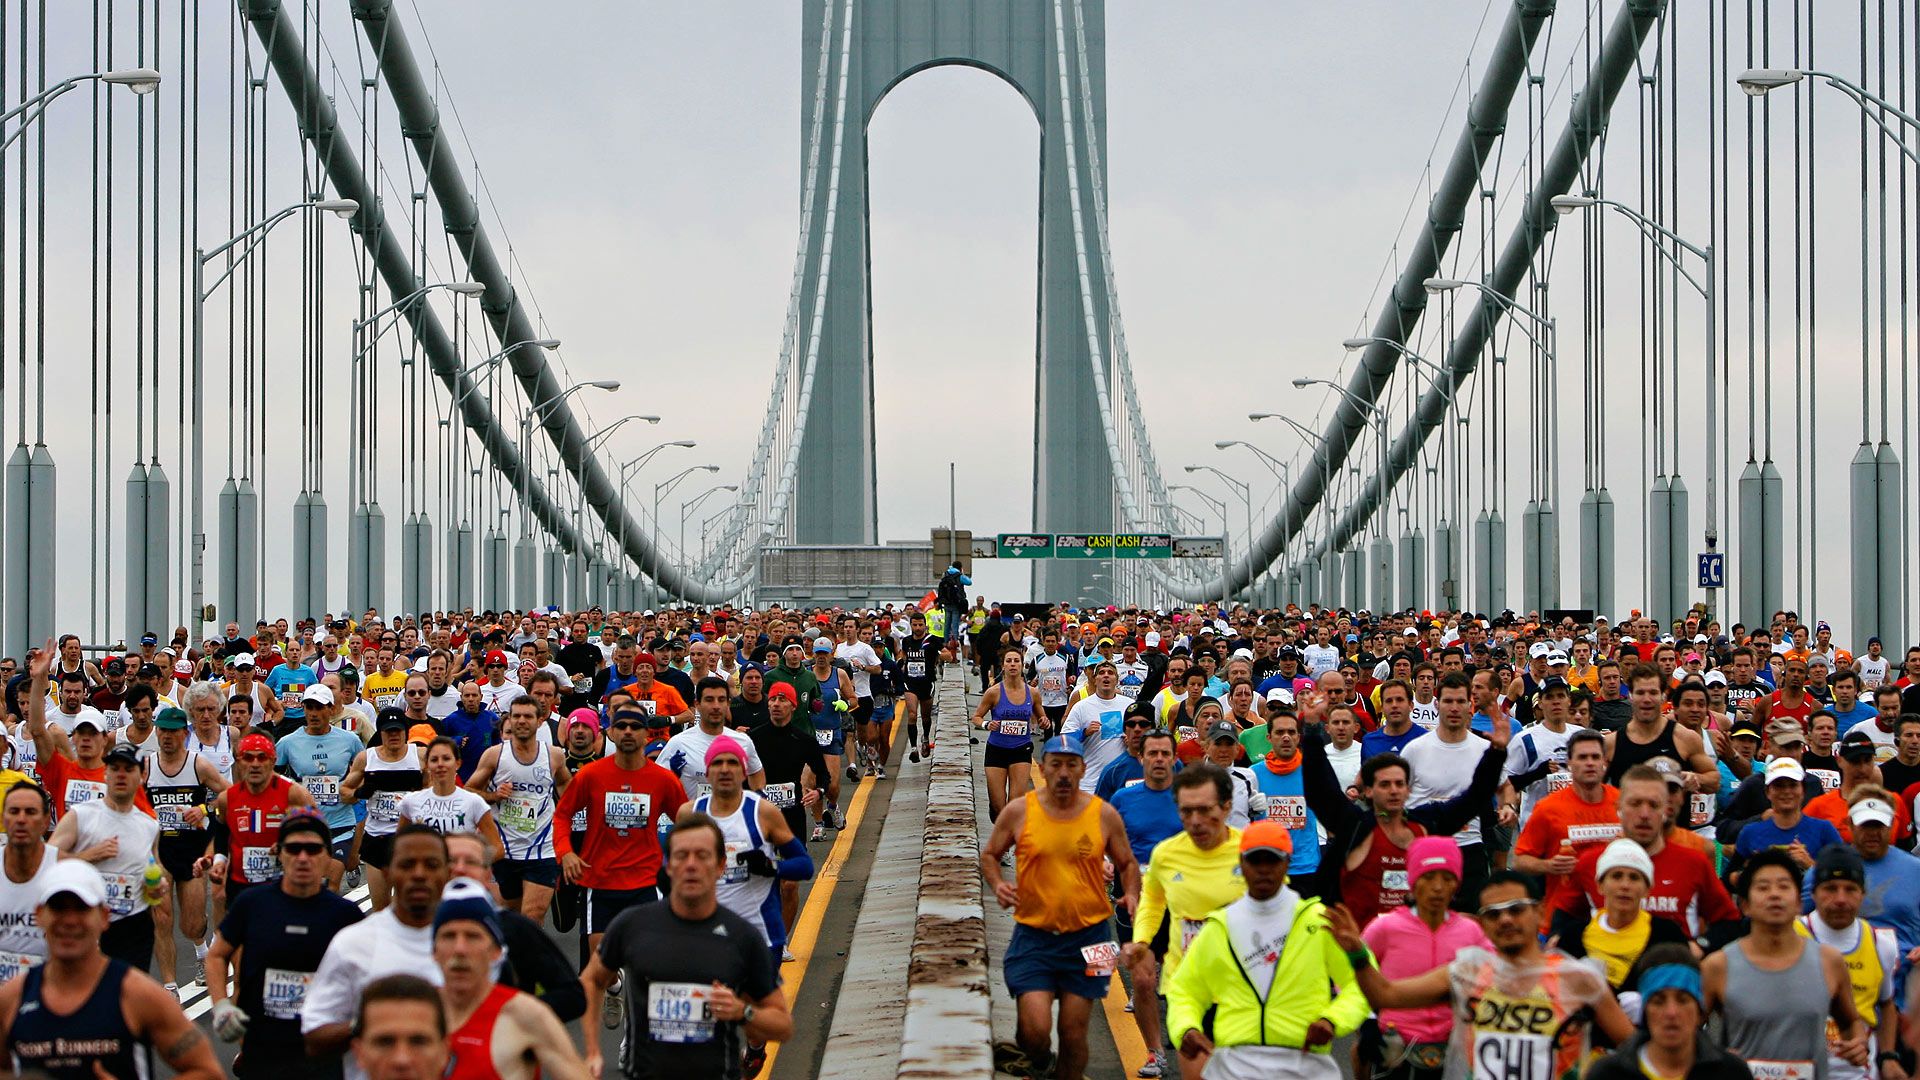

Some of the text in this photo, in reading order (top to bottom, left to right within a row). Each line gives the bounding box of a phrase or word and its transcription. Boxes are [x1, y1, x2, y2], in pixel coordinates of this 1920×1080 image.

[1087, 536, 1112, 547] CASH
[1116, 536, 1140, 547] CASH
[1728, 689, 1757, 699] DISCO
[311, 752, 329, 760] ITALIA
[329, 783, 336, 794] B
[512, 782, 544, 794] ESCO
[152, 792, 194, 805] DEREK
[420, 798, 462, 813] ANNE
[606, 802, 646, 816] 10595 F
[1268, 805, 1303, 817] 12251 C
[527, 807, 535, 819] A
[246, 856, 270, 869] 4073
[656, 999, 691, 1020] 4149
